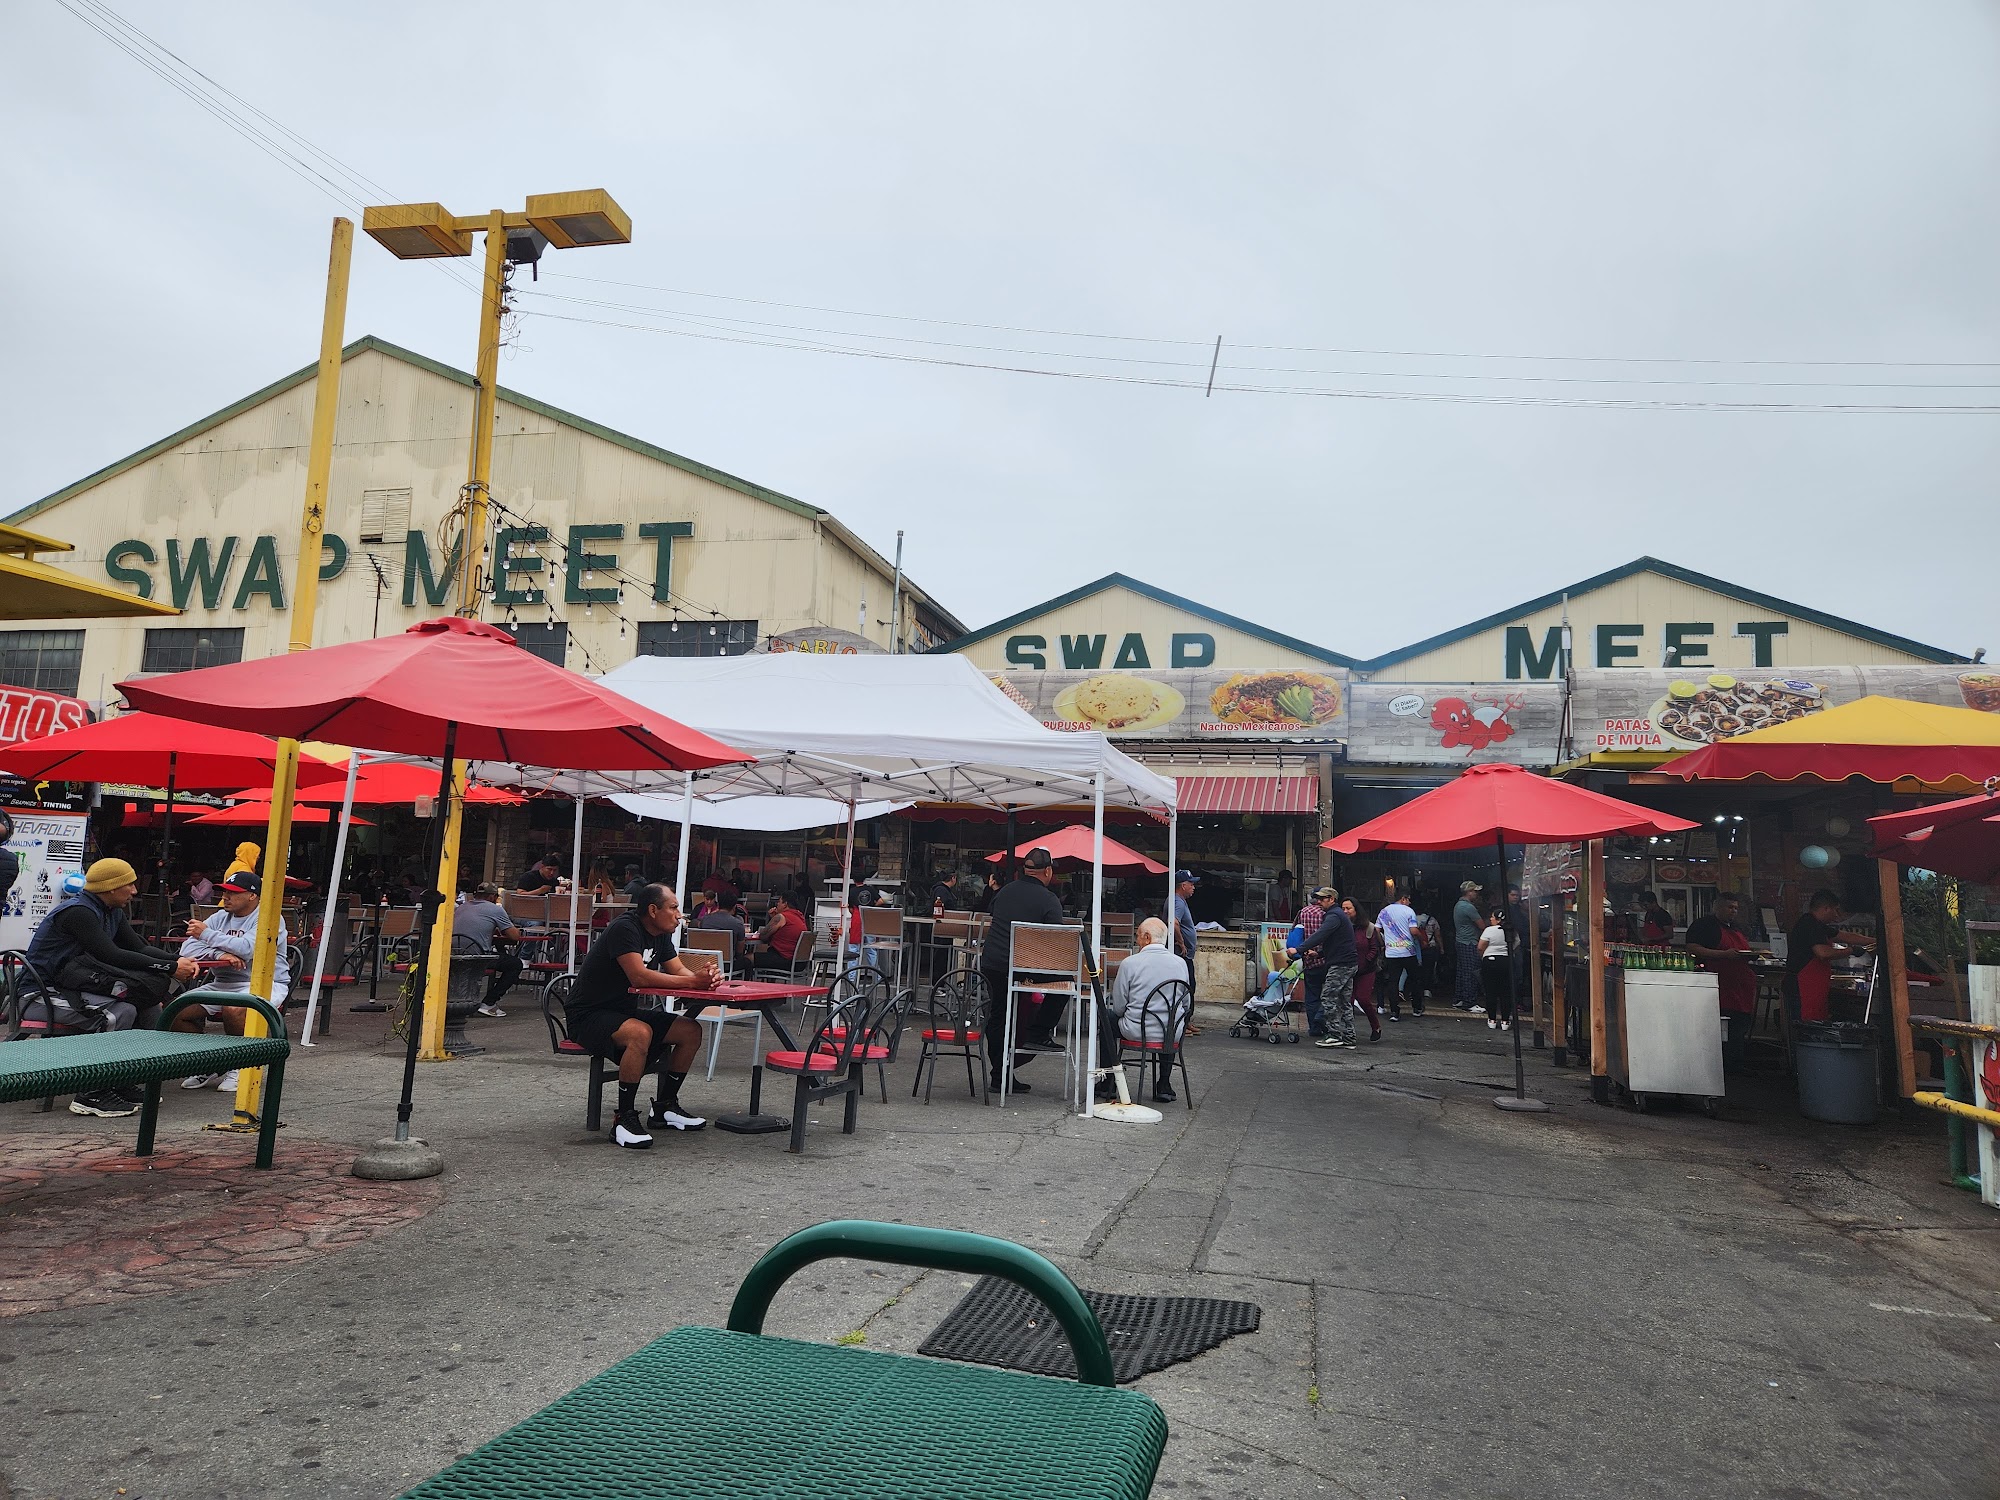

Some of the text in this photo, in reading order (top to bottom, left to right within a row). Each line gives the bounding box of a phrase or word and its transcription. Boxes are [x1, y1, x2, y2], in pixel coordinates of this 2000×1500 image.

[401, 521, 695, 607] MEET
[1505, 621, 1789, 680] MEET
[0, 689, 83, 743] TOS
[1043, 720, 1092, 731] PUPUSAS
[1200, 720, 1301, 732] Nachos Mexicanos
[1605, 719, 1652, 732] PATAS
[1597, 734, 1663, 746] DE MULA
[42, 801, 72, 810] TINTING
[14, 820, 81, 838] HEVROLET
